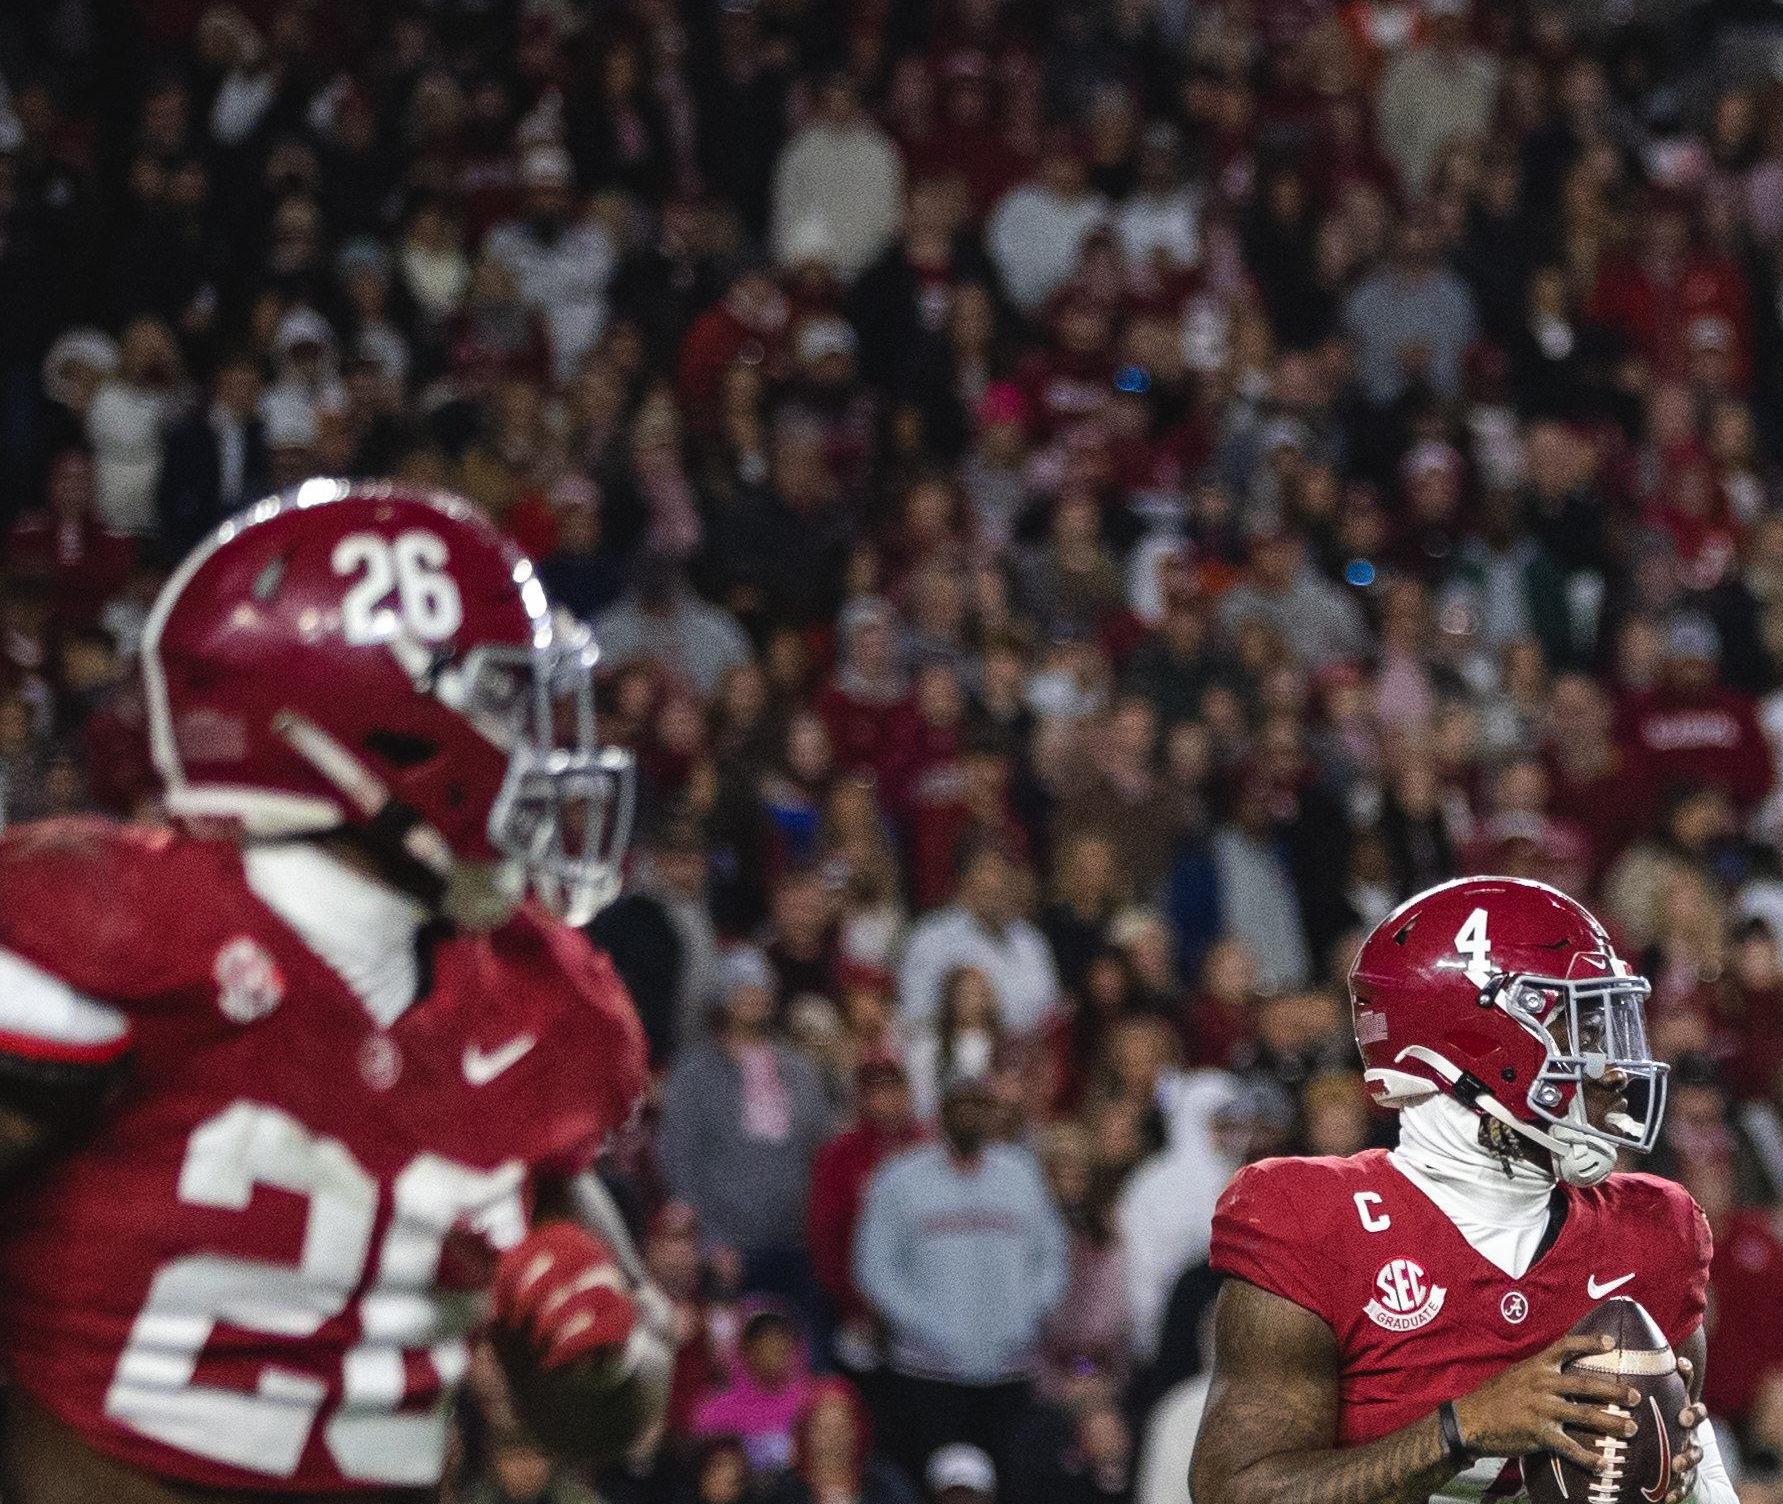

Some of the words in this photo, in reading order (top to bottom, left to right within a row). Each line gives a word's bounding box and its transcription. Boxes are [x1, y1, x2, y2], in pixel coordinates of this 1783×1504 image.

[331, 531, 462, 645] 26
[1454, 908, 1491, 973] 4
[1353, 1191, 1391, 1232] C
[1376, 1259, 1427, 1311] SEC
[1376, 1301, 1440, 1330] GRADUATE
